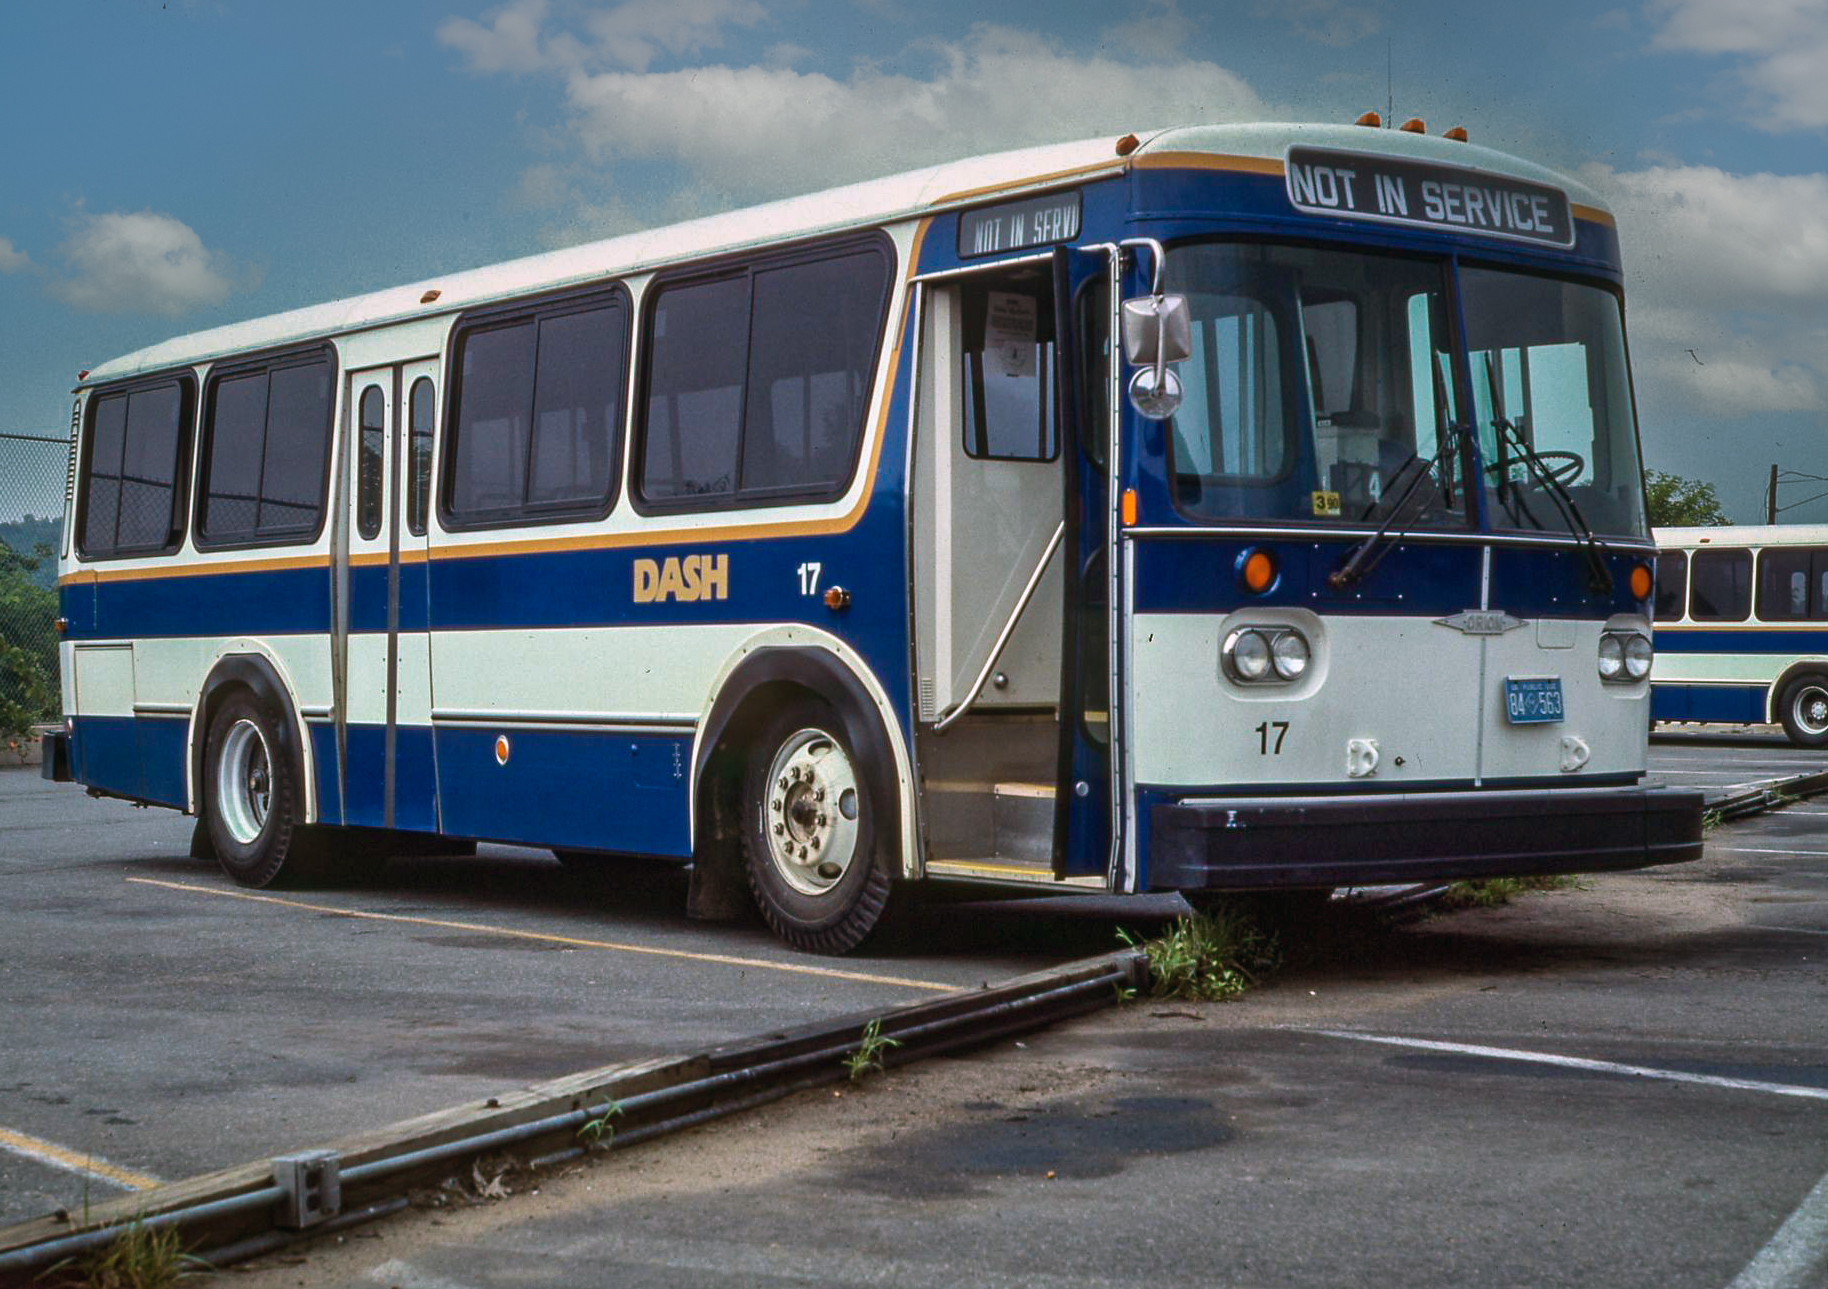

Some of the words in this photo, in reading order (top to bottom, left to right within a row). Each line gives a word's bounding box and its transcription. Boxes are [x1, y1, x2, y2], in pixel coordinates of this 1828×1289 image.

[1291, 163, 1356, 209] NOT
[1374, 173, 1408, 216] IN
[1421, 180, 1554, 233] SERVICE
[974, 218, 1001, 253] NOT
[1010, 213, 1025, 248] IN
[633, 554, 729, 603] DASH
[797, 562, 821, 595] 17
[1538, 691, 1561, 715] 563
[1255, 721, 1290, 755] 17
